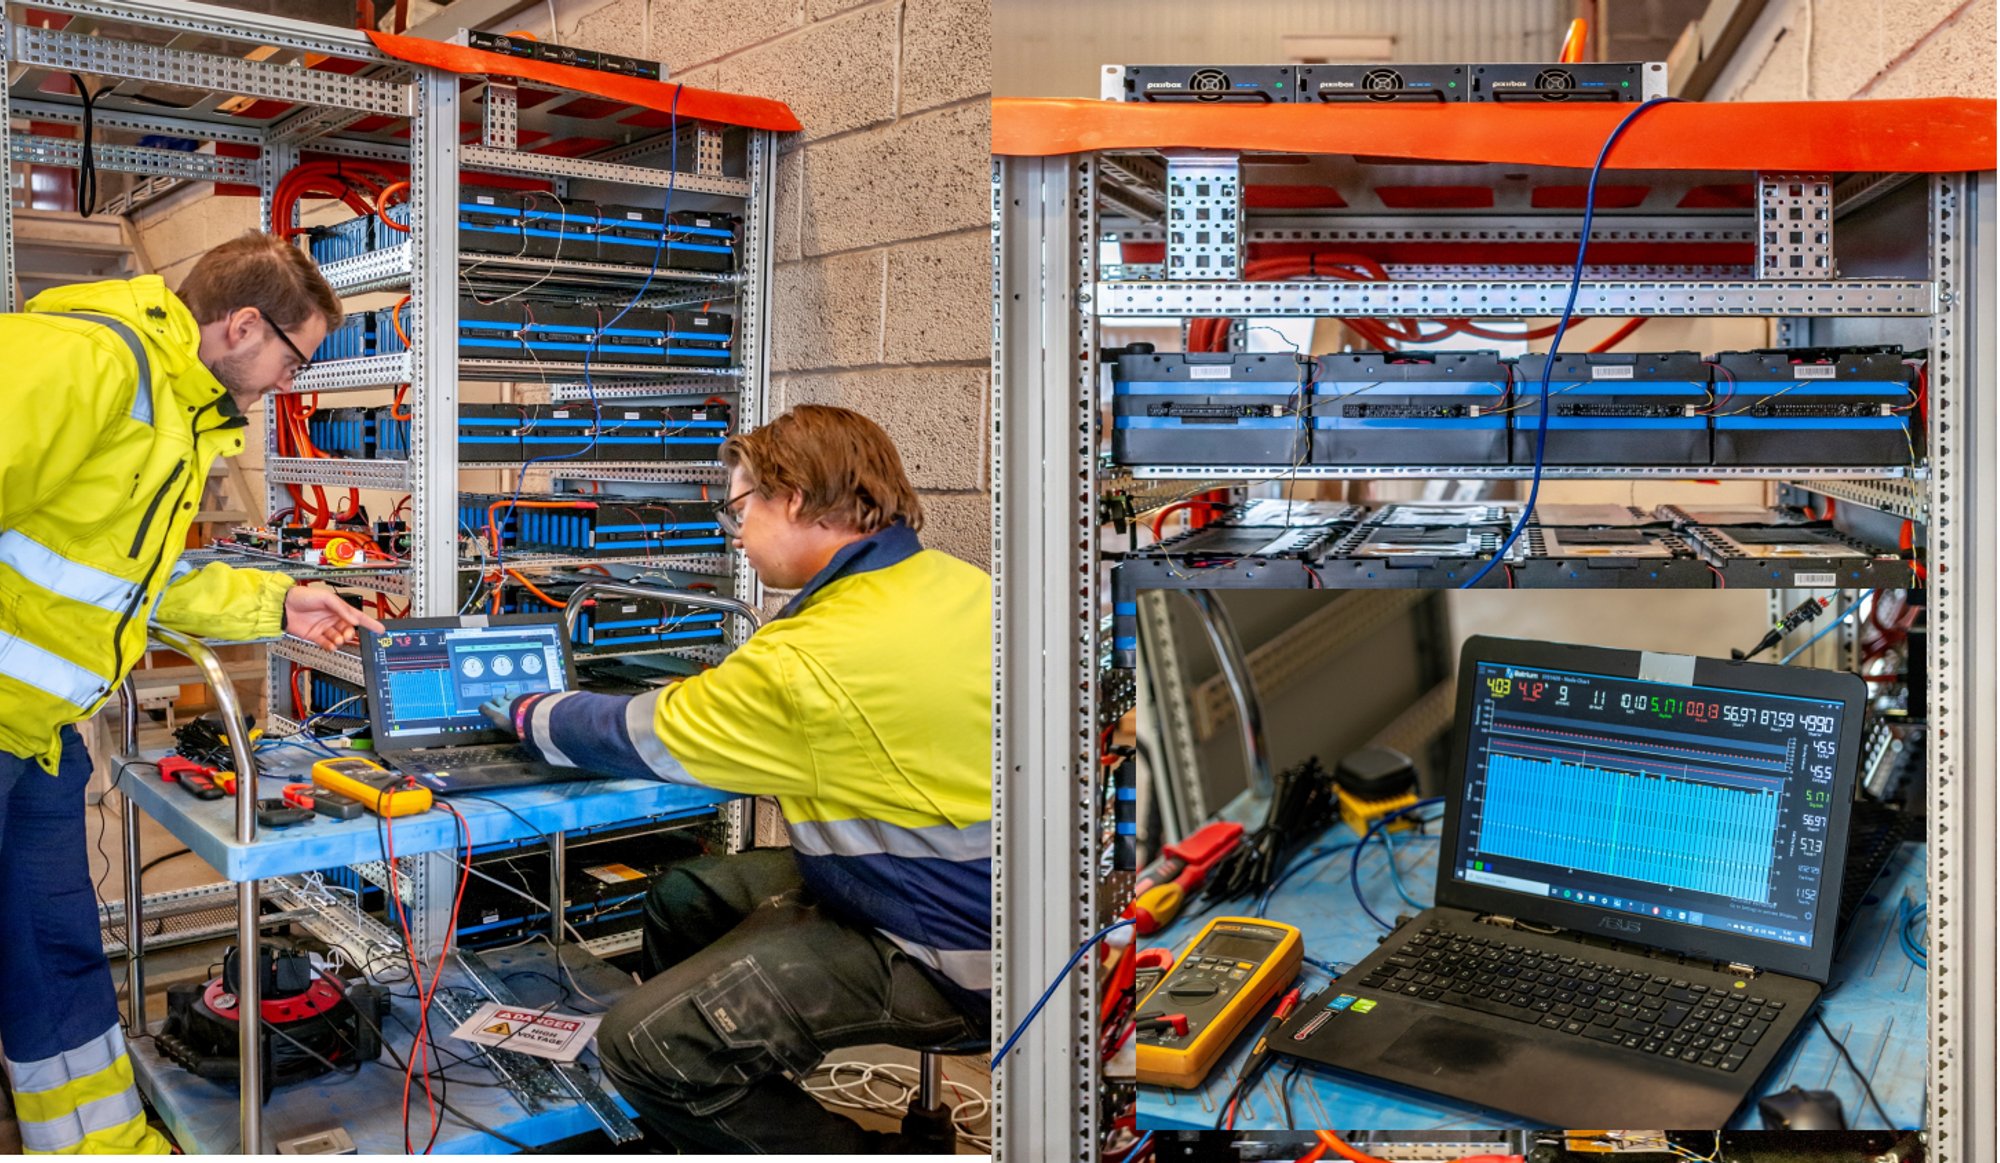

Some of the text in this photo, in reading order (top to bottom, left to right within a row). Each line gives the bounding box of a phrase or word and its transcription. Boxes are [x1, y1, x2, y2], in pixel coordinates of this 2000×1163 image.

[1559, 685, 1568, 701] 9
[1723, 705, 1756, 723] 56.97
[1760, 709, 1795, 728] 87.59
[1799, 714, 1834, 733] 4990
[1598, 916, 1641, 933] ASUS
[512, 1014, 575, 1029] DANGER
[518, 1032, 563, 1045] VOLTAGE
[531, 1028, 558, 1037] HIGH
